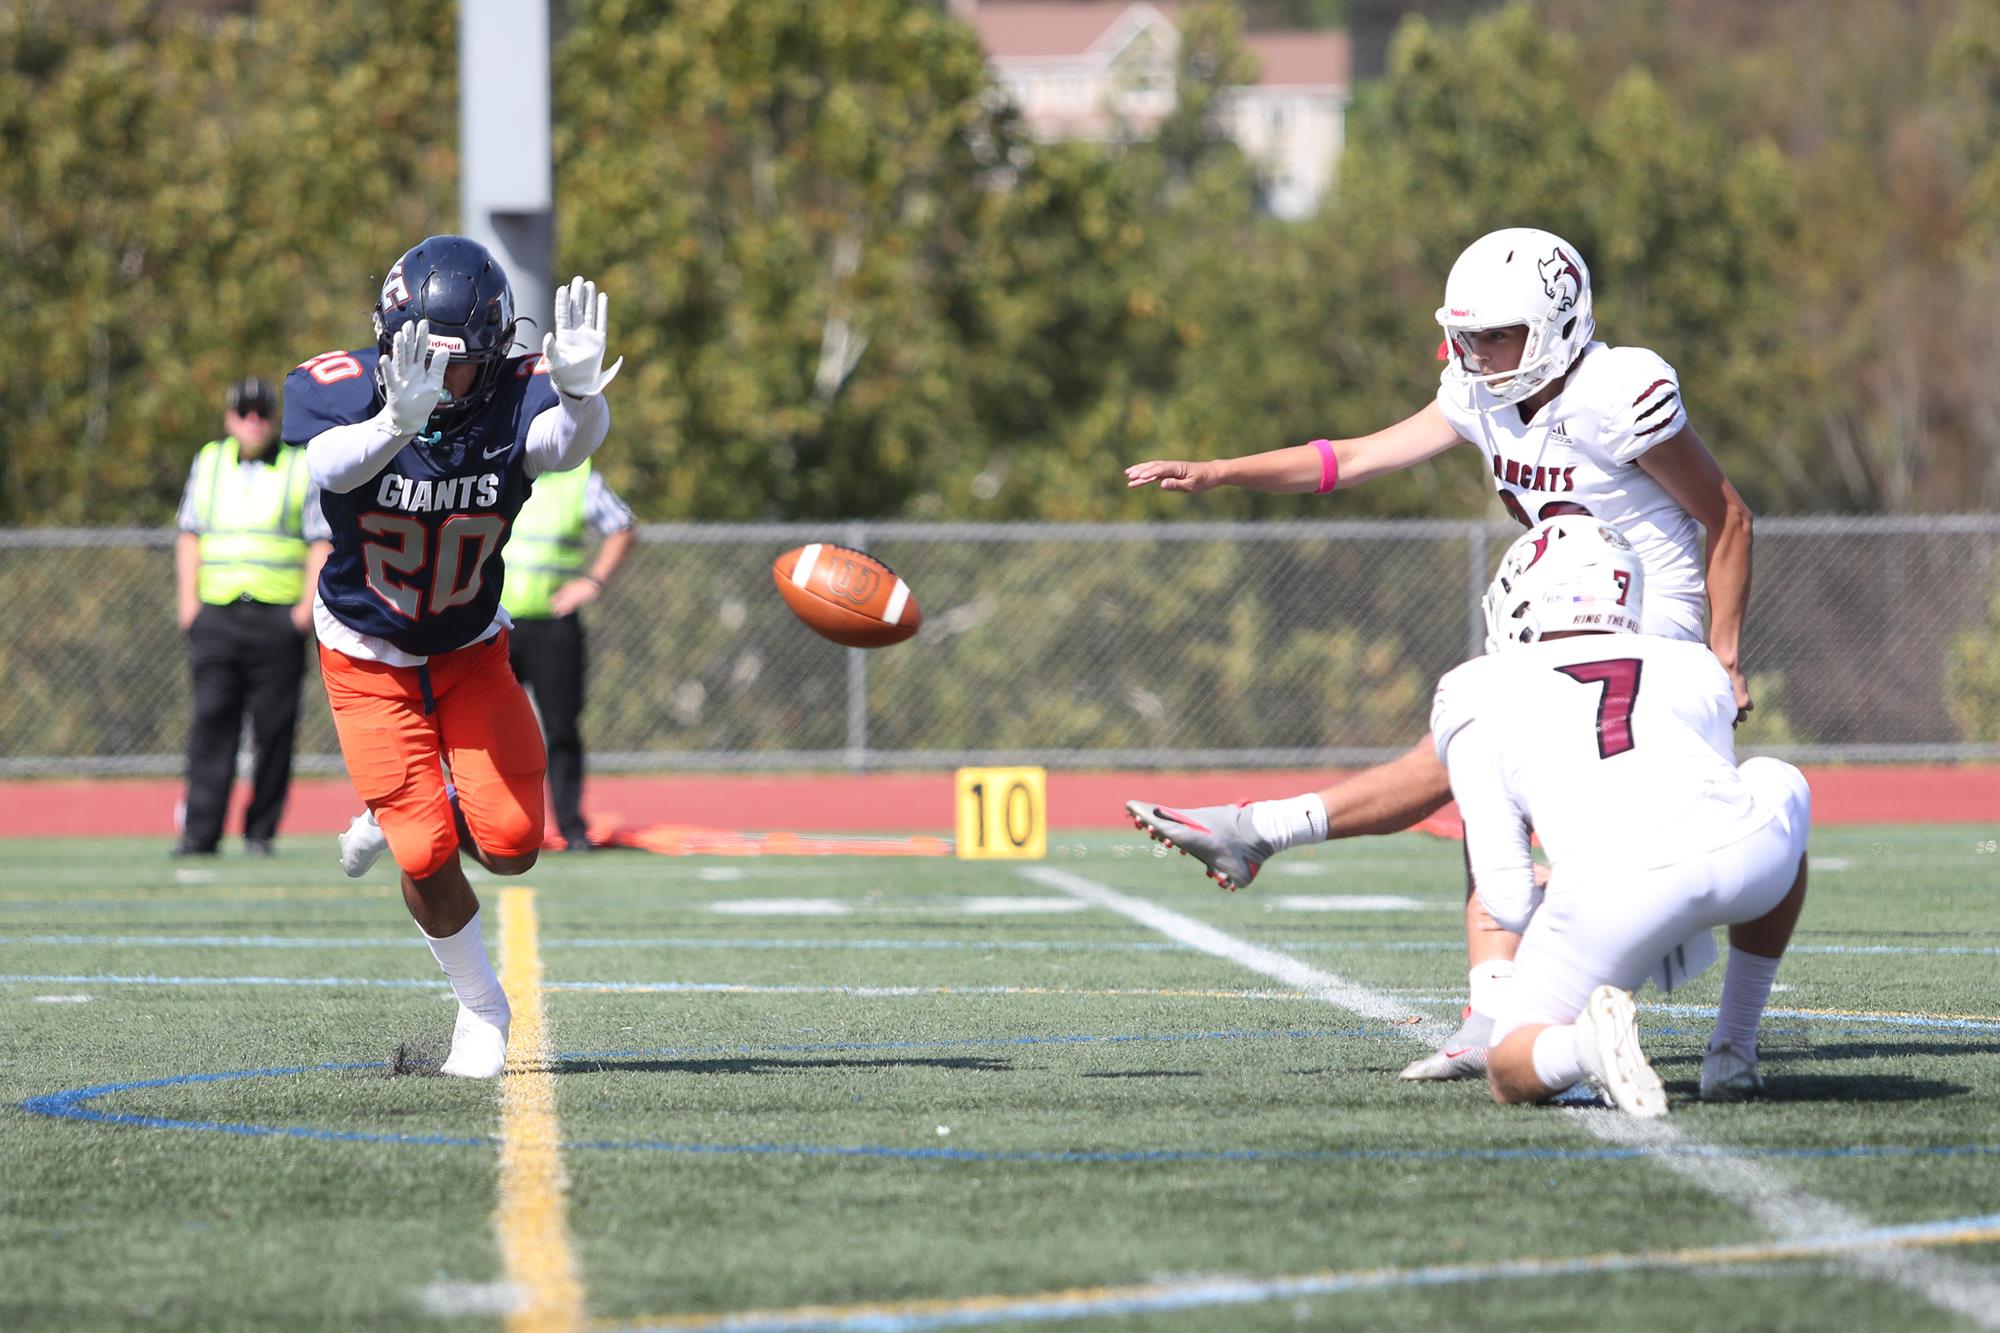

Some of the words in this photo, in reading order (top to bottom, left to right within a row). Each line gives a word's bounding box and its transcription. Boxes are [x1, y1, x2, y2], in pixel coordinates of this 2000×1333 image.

[376, 473, 499, 512] GIANTS
[358, 512, 508, 622] 20
[1613, 569, 1631, 606] 7
[1607, 614, 1625, 627] THE
[1553, 658, 1643, 760] 7
[971, 782, 1033, 848] 10
